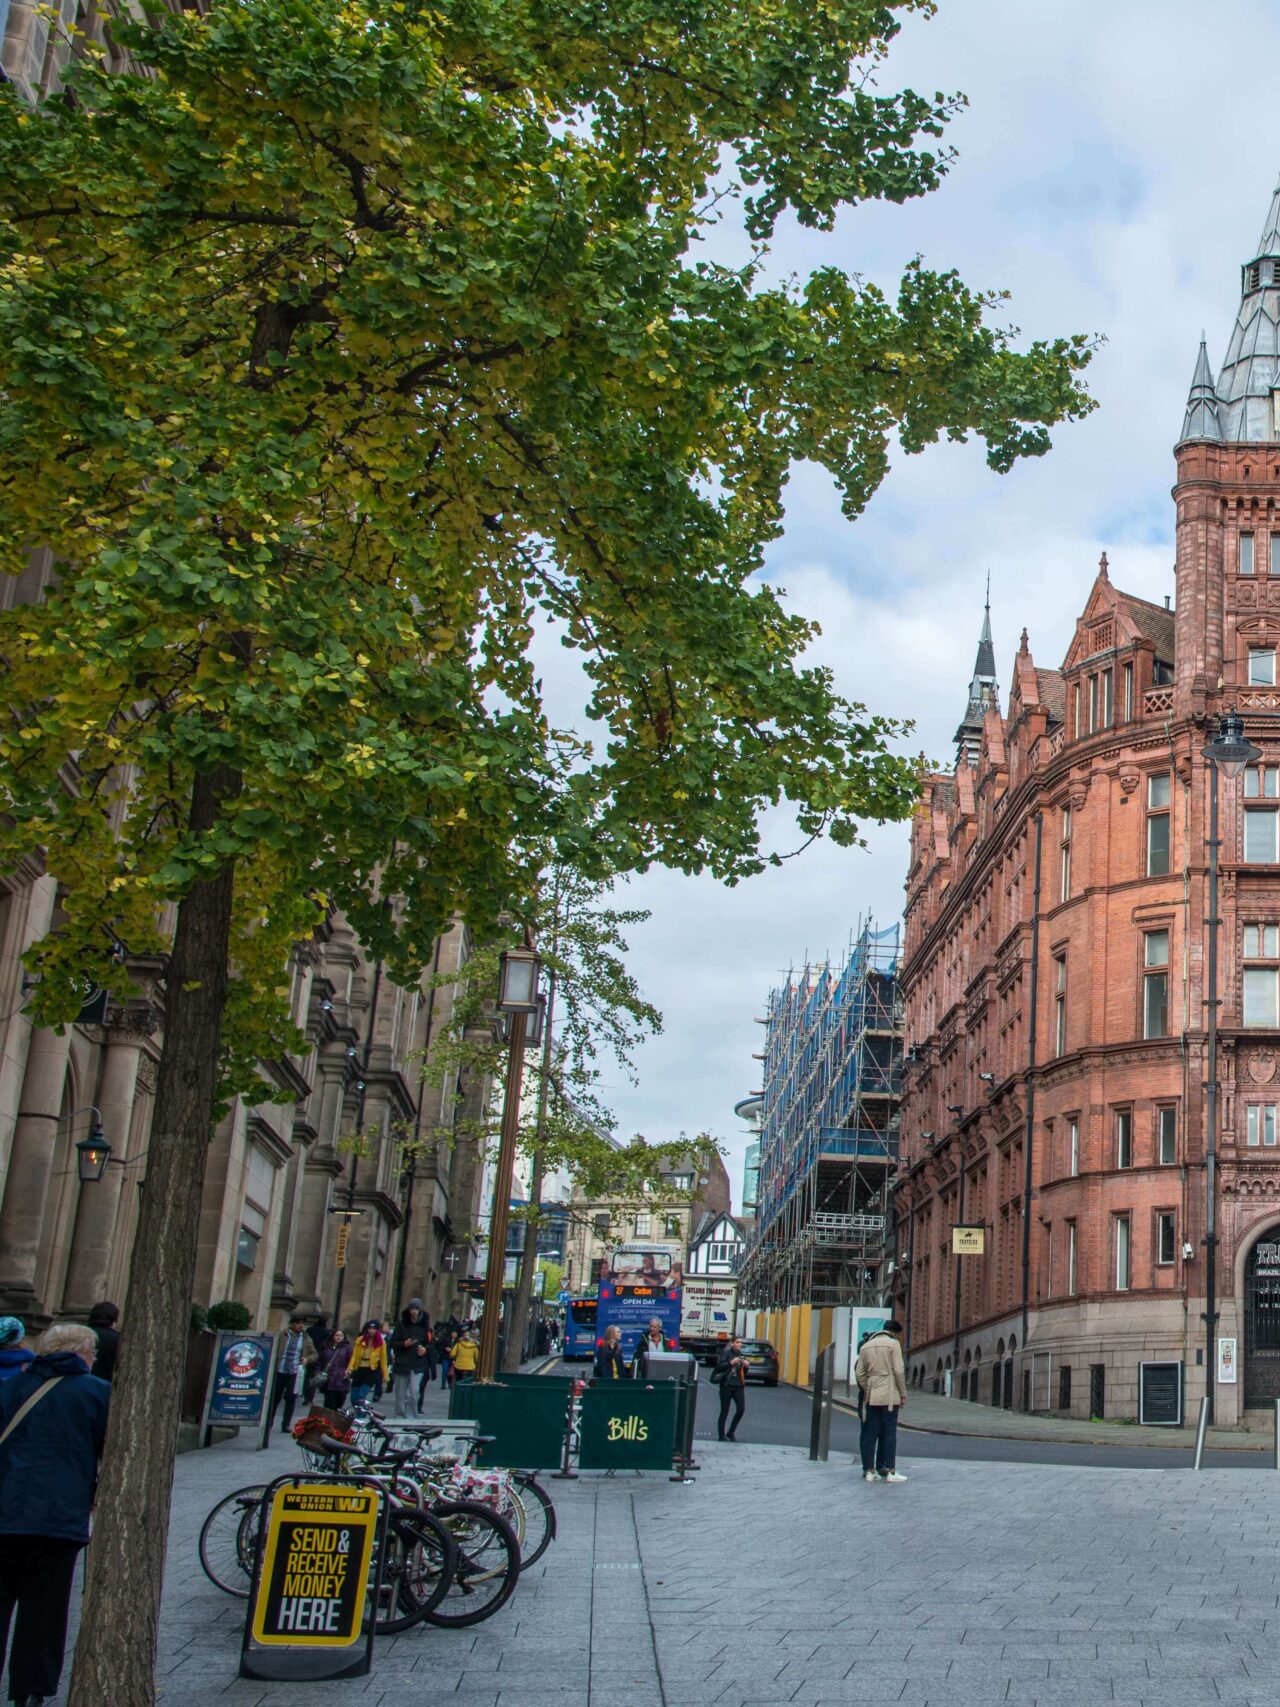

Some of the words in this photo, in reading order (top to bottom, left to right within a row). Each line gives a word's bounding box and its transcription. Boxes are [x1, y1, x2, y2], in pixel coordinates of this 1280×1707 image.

[607, 1415, 649, 1441] Bill's
[286, 1495, 334, 1504] WESTERN
[300, 1503, 333, 1511] UNION
[290, 1528, 338, 1552] SEND
[338, 1529, 350, 1553] &
[286, 1552, 348, 1575] RECEIVE
[283, 1574, 345, 1598] MONEY
[277, 1598, 342, 1631] HERE
